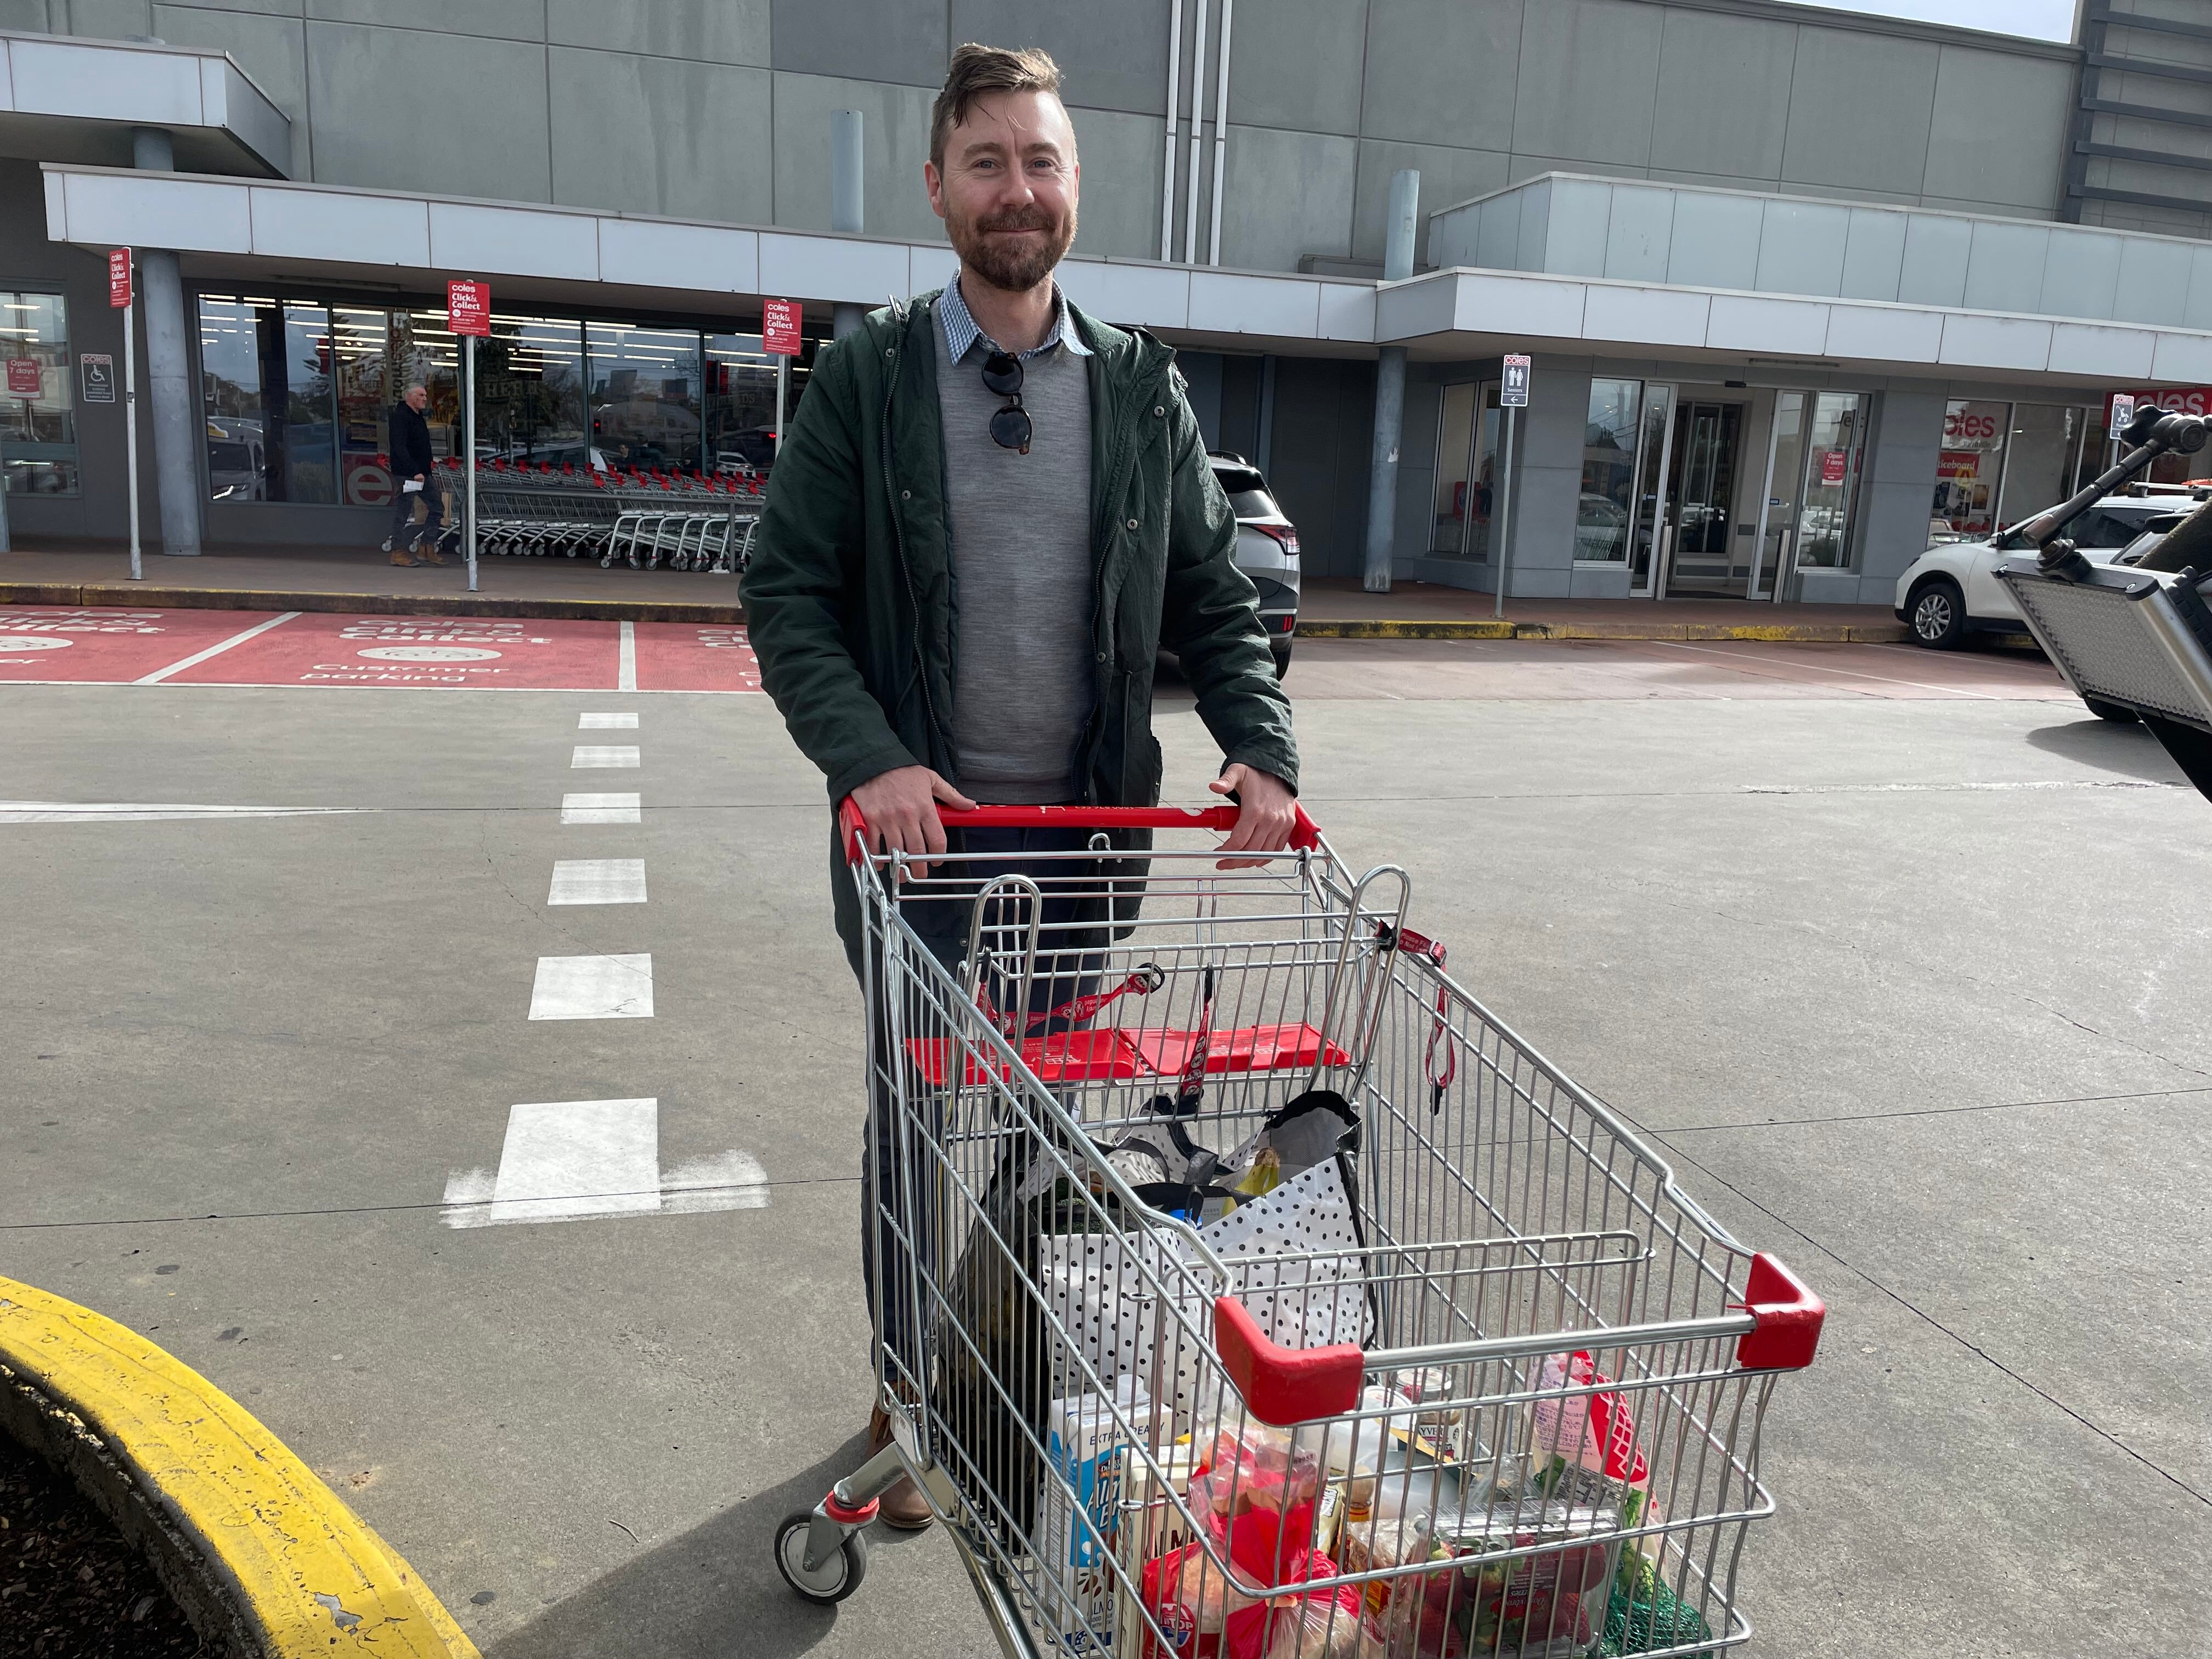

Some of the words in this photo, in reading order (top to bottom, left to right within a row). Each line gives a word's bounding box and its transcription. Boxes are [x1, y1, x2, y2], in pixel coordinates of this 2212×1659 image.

[452, 284, 476, 293] coles
[452, 301, 480, 310] Collect
[768, 303, 789, 312] coles
[767, 320, 793, 329] Collect
[83, 356, 110, 364] coles
[1505, 356, 1529, 364] coles
[2134, 391, 2204, 417] oles
[357, 620, 524, 629] coles
[339, 633, 552, 644] Collect
[313, 664, 510, 673] Customer
[300, 673, 466, 682] parking
[1400, 933, 1419, 943] Please
